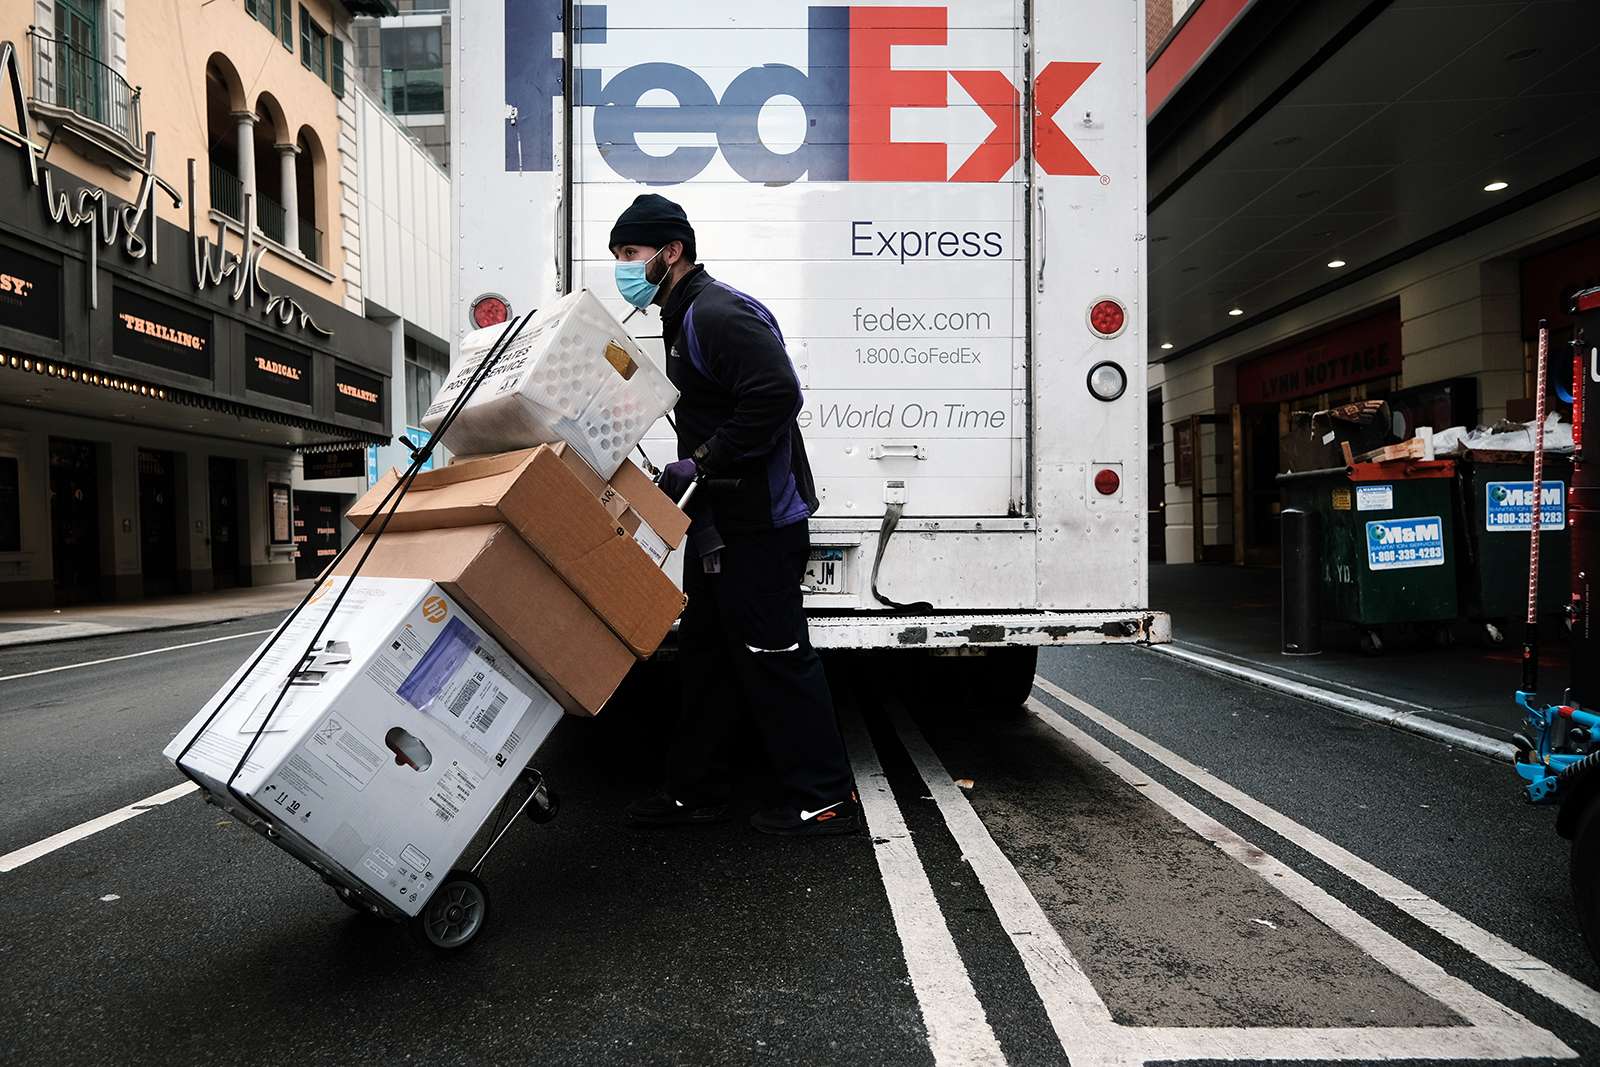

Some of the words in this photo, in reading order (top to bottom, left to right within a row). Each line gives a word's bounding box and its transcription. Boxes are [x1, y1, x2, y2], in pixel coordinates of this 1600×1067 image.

[505, 0, 1101, 186] FedEx
[851, 220, 1003, 264] Express
[852, 306, 991, 332] fedex.com
[855, 346, 982, 367] 1.800.GoFedEx
[1263, 370, 1300, 399] LYNN
[1306, 343, 1391, 387] NOTTAGE
[819, 403, 895, 429] World
[901, 403, 938, 429] On
[944, 403, 1006, 429] Time
[1490, 512, 1562, 524] 1-800-334283
[1380, 524, 1439, 545] M&M
[423, 596, 448, 623] hp
[290, 800, 301, 811] 10
